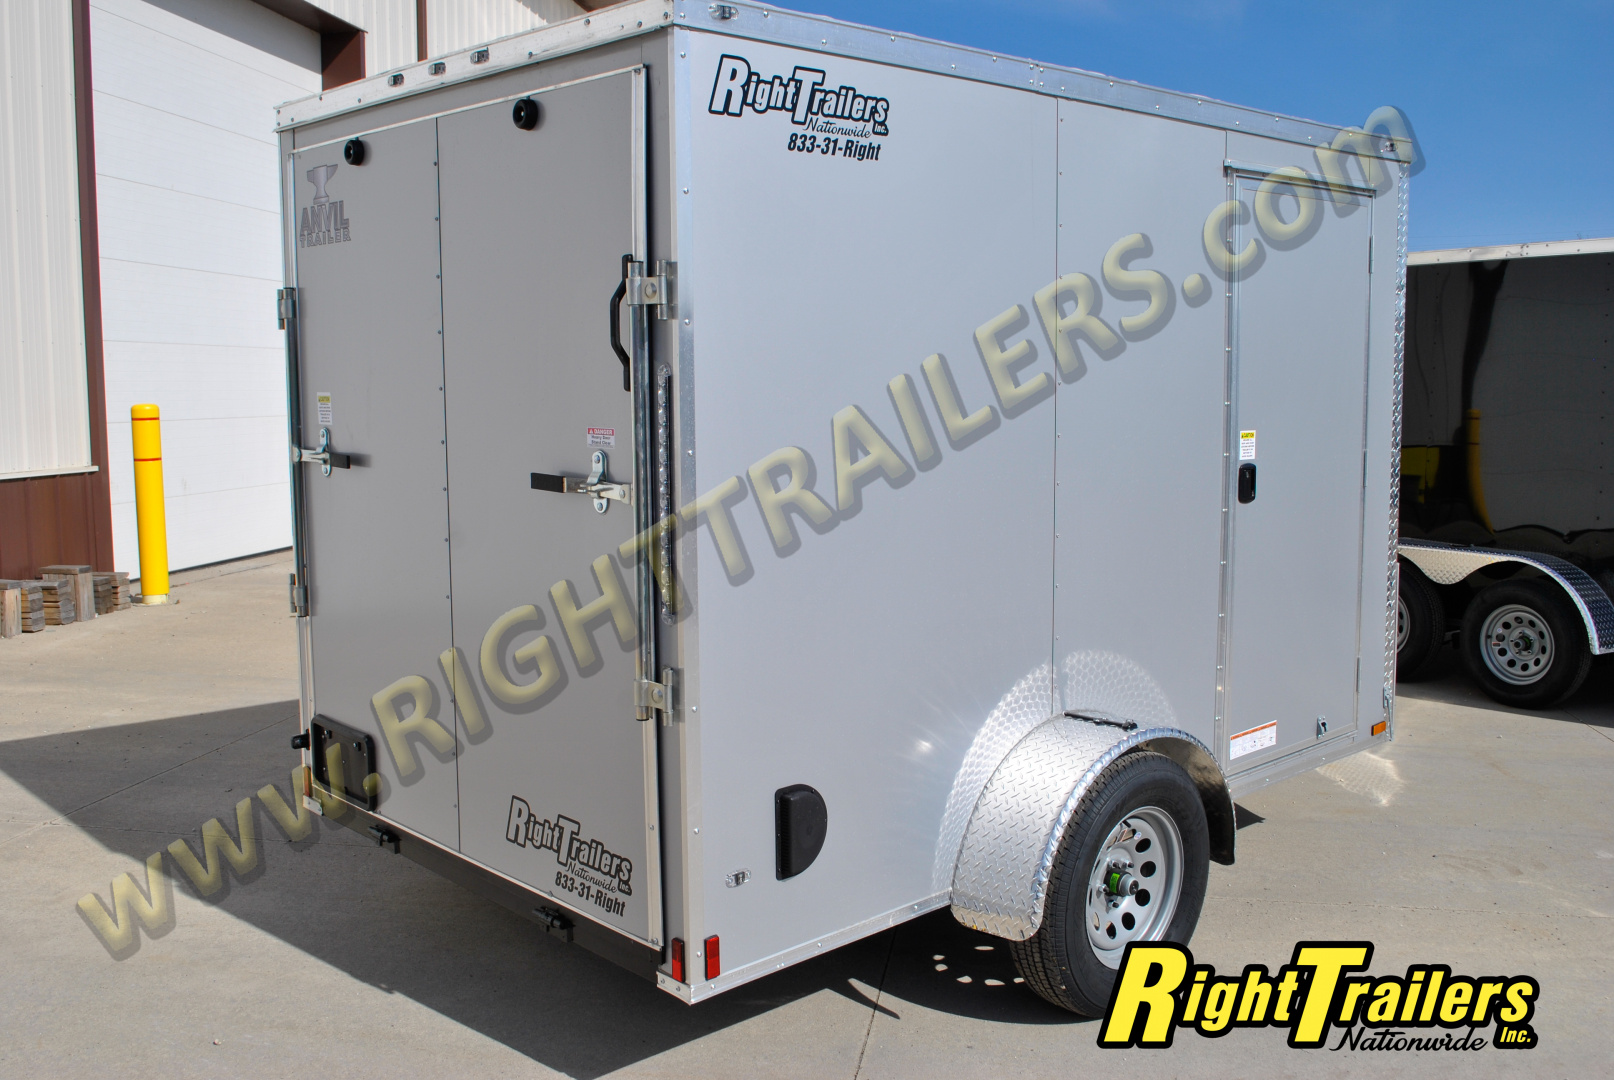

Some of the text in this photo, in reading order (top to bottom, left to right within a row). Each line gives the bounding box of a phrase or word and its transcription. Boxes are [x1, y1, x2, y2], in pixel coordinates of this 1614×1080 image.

[802, 116, 889, 139] Nationwide Inc.
[787, 132, 882, 161] 833-31-Right
[300, 200, 350, 234] ANVIL
[300, 227, 351, 248] TRAILER
[565, 861, 632, 895] Nationwide Inc.
[555, 871, 626, 917] 833-31-Right
